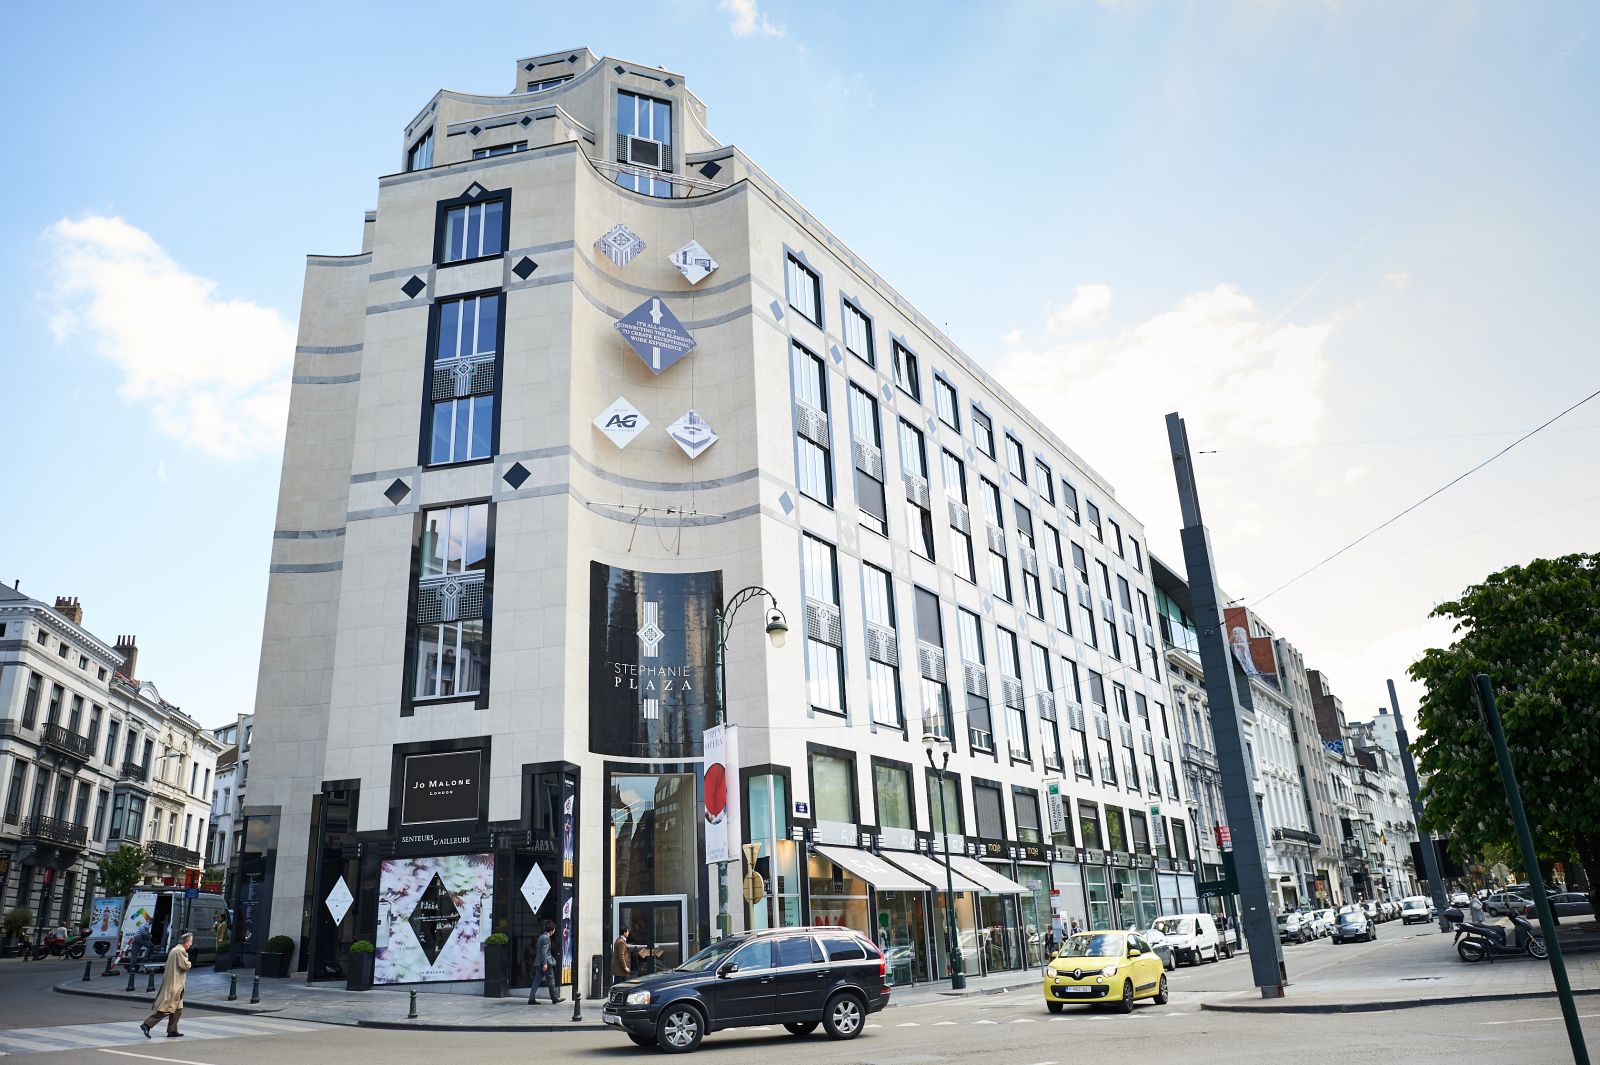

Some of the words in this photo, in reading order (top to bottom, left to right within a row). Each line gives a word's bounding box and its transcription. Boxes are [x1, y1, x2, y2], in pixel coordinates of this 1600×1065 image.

[616, 322, 654, 334] CONNECTING
[659, 326, 677, 334] ABOUT
[630, 336, 648, 344] WORK
[648, 339, 682, 351] EXPERIENCE
[631, 330, 653, 339] CREATE
[653, 334, 690, 348] EXCEPTIONAL
[605, 414, 638, 428] AG
[614, 662, 691, 677] STEPHANIE
[614, 676, 692, 691] PLAZA
[428, 779, 471, 788] MALONE
[401, 834, 434, 843] SENTEURS
[433, 836, 470, 846] D'AILLEURS
